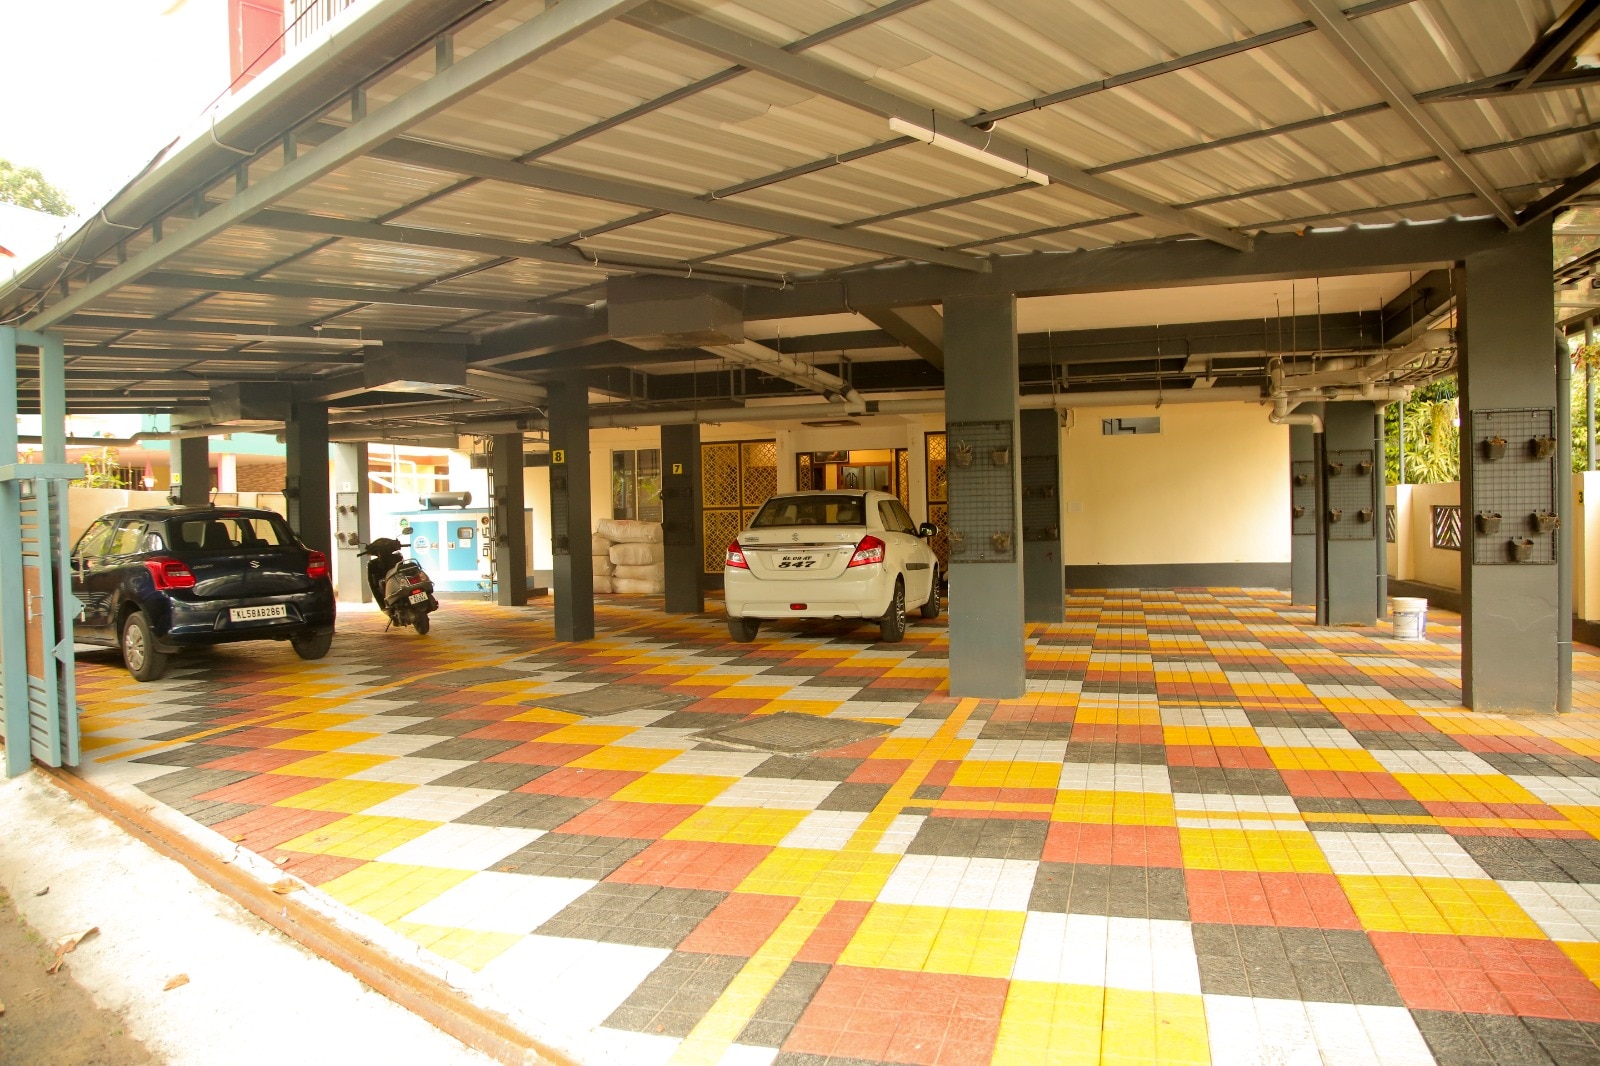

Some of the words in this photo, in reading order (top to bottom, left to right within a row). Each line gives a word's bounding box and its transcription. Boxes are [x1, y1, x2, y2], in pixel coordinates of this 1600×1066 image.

[554, 451, 562, 462] 8
[674, 464, 681, 473] 7
[1578, 491, 1584, 504] 3
[778, 560, 816, 569] 847
[236, 606, 286, 619] KL58AB2861
